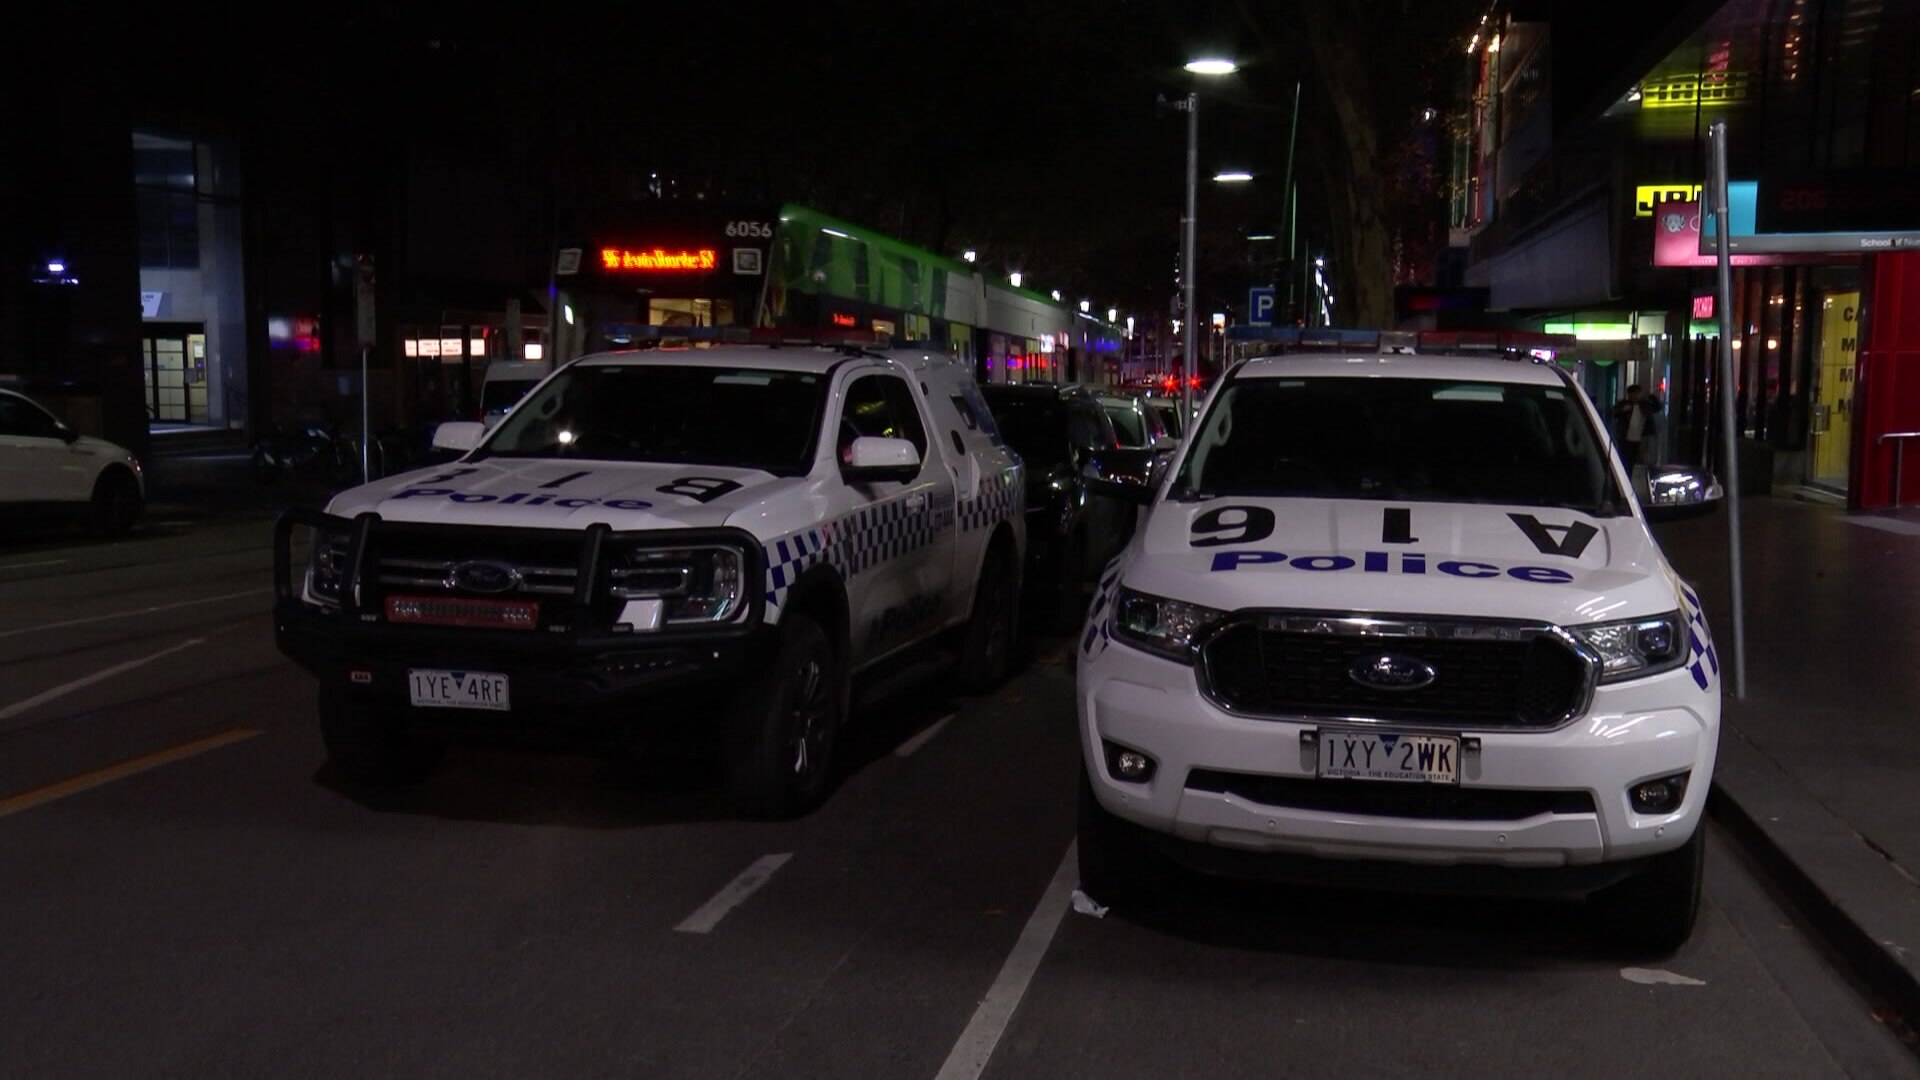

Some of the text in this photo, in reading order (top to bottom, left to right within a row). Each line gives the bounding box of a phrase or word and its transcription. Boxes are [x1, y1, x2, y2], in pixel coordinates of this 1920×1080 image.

[725, 220, 773, 239] 6056
[1258, 291, 1275, 319] P
[391, 488, 653, 510] Police
[1211, 551, 1574, 583] Police
[416, 675, 503, 702] 1YE 4RF
[1328, 738, 1452, 773] 1XY 2WK
